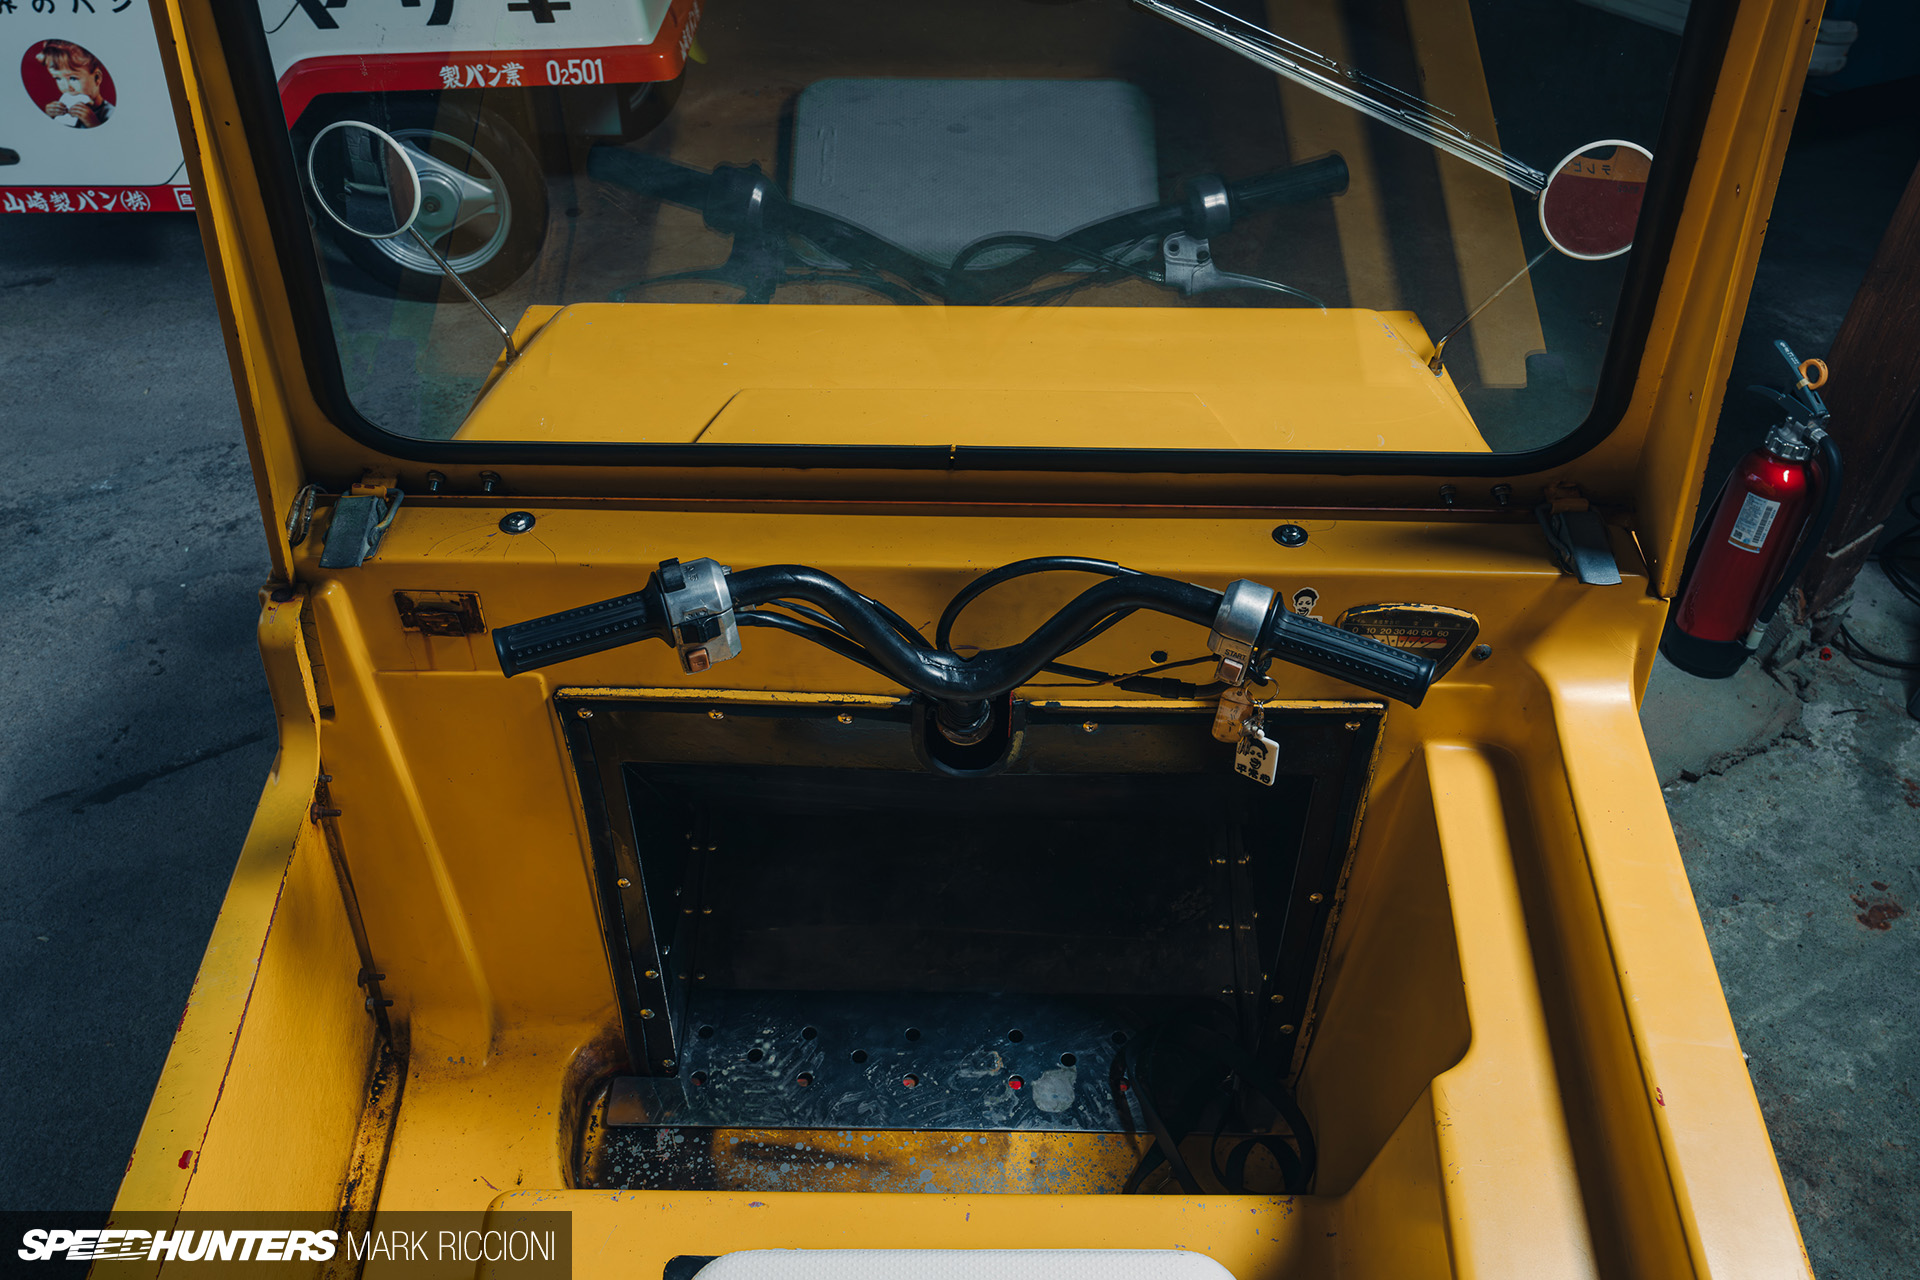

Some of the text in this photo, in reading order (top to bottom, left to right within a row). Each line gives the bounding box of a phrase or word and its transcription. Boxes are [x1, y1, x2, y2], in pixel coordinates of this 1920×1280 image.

[438, 61, 525, 90] 製パン業
[1352, 626, 1359, 634] 0
[1224, 649, 1247, 661] START
